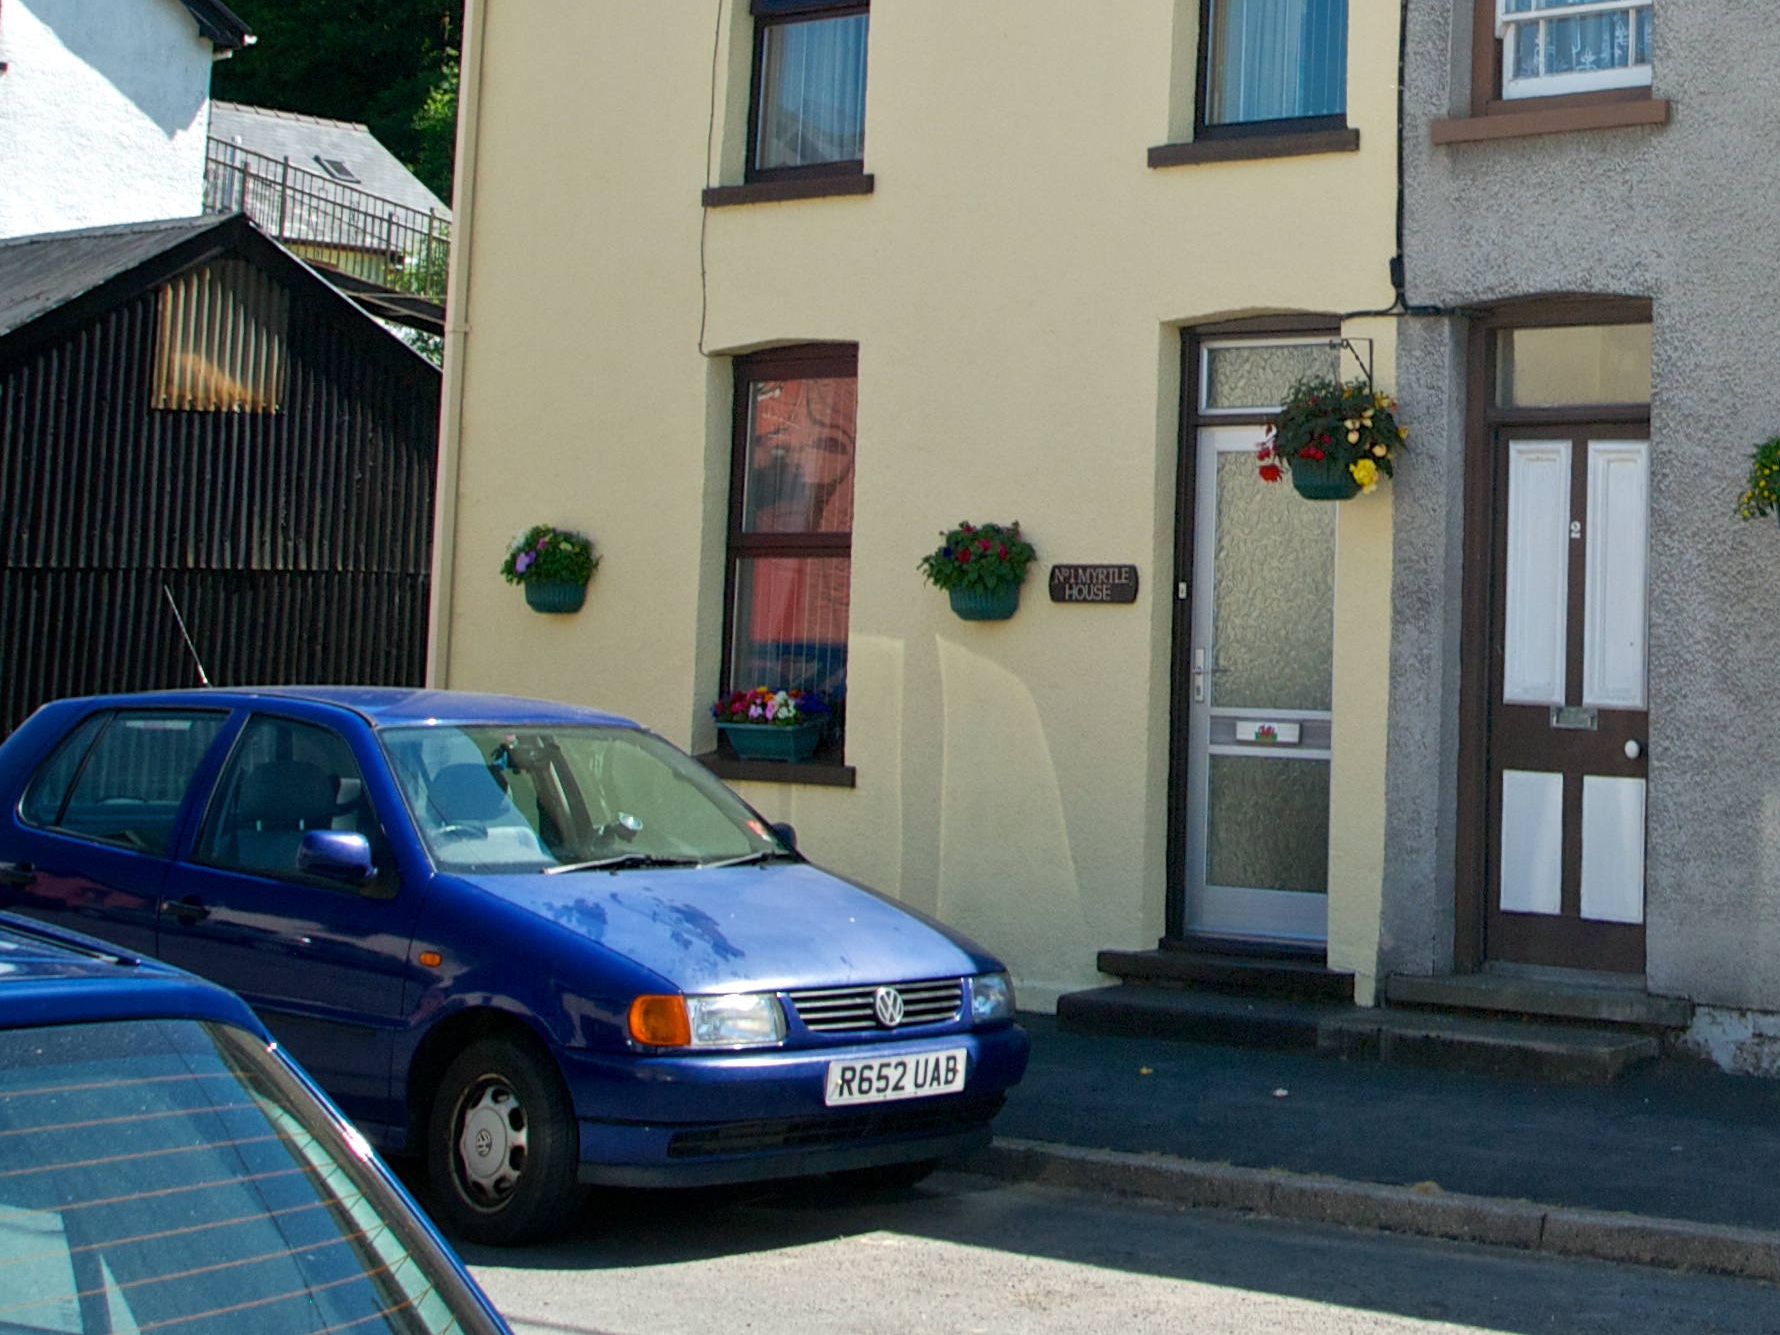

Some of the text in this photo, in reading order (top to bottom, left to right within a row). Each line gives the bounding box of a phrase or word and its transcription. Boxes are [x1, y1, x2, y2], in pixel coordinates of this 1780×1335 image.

[1570, 520, 1581, 539] 2
[1077, 567, 1130, 584] MYRTLE
[1065, 584, 1112, 601] HOUSE
[838, 1055, 958, 1098] R652 UAB
